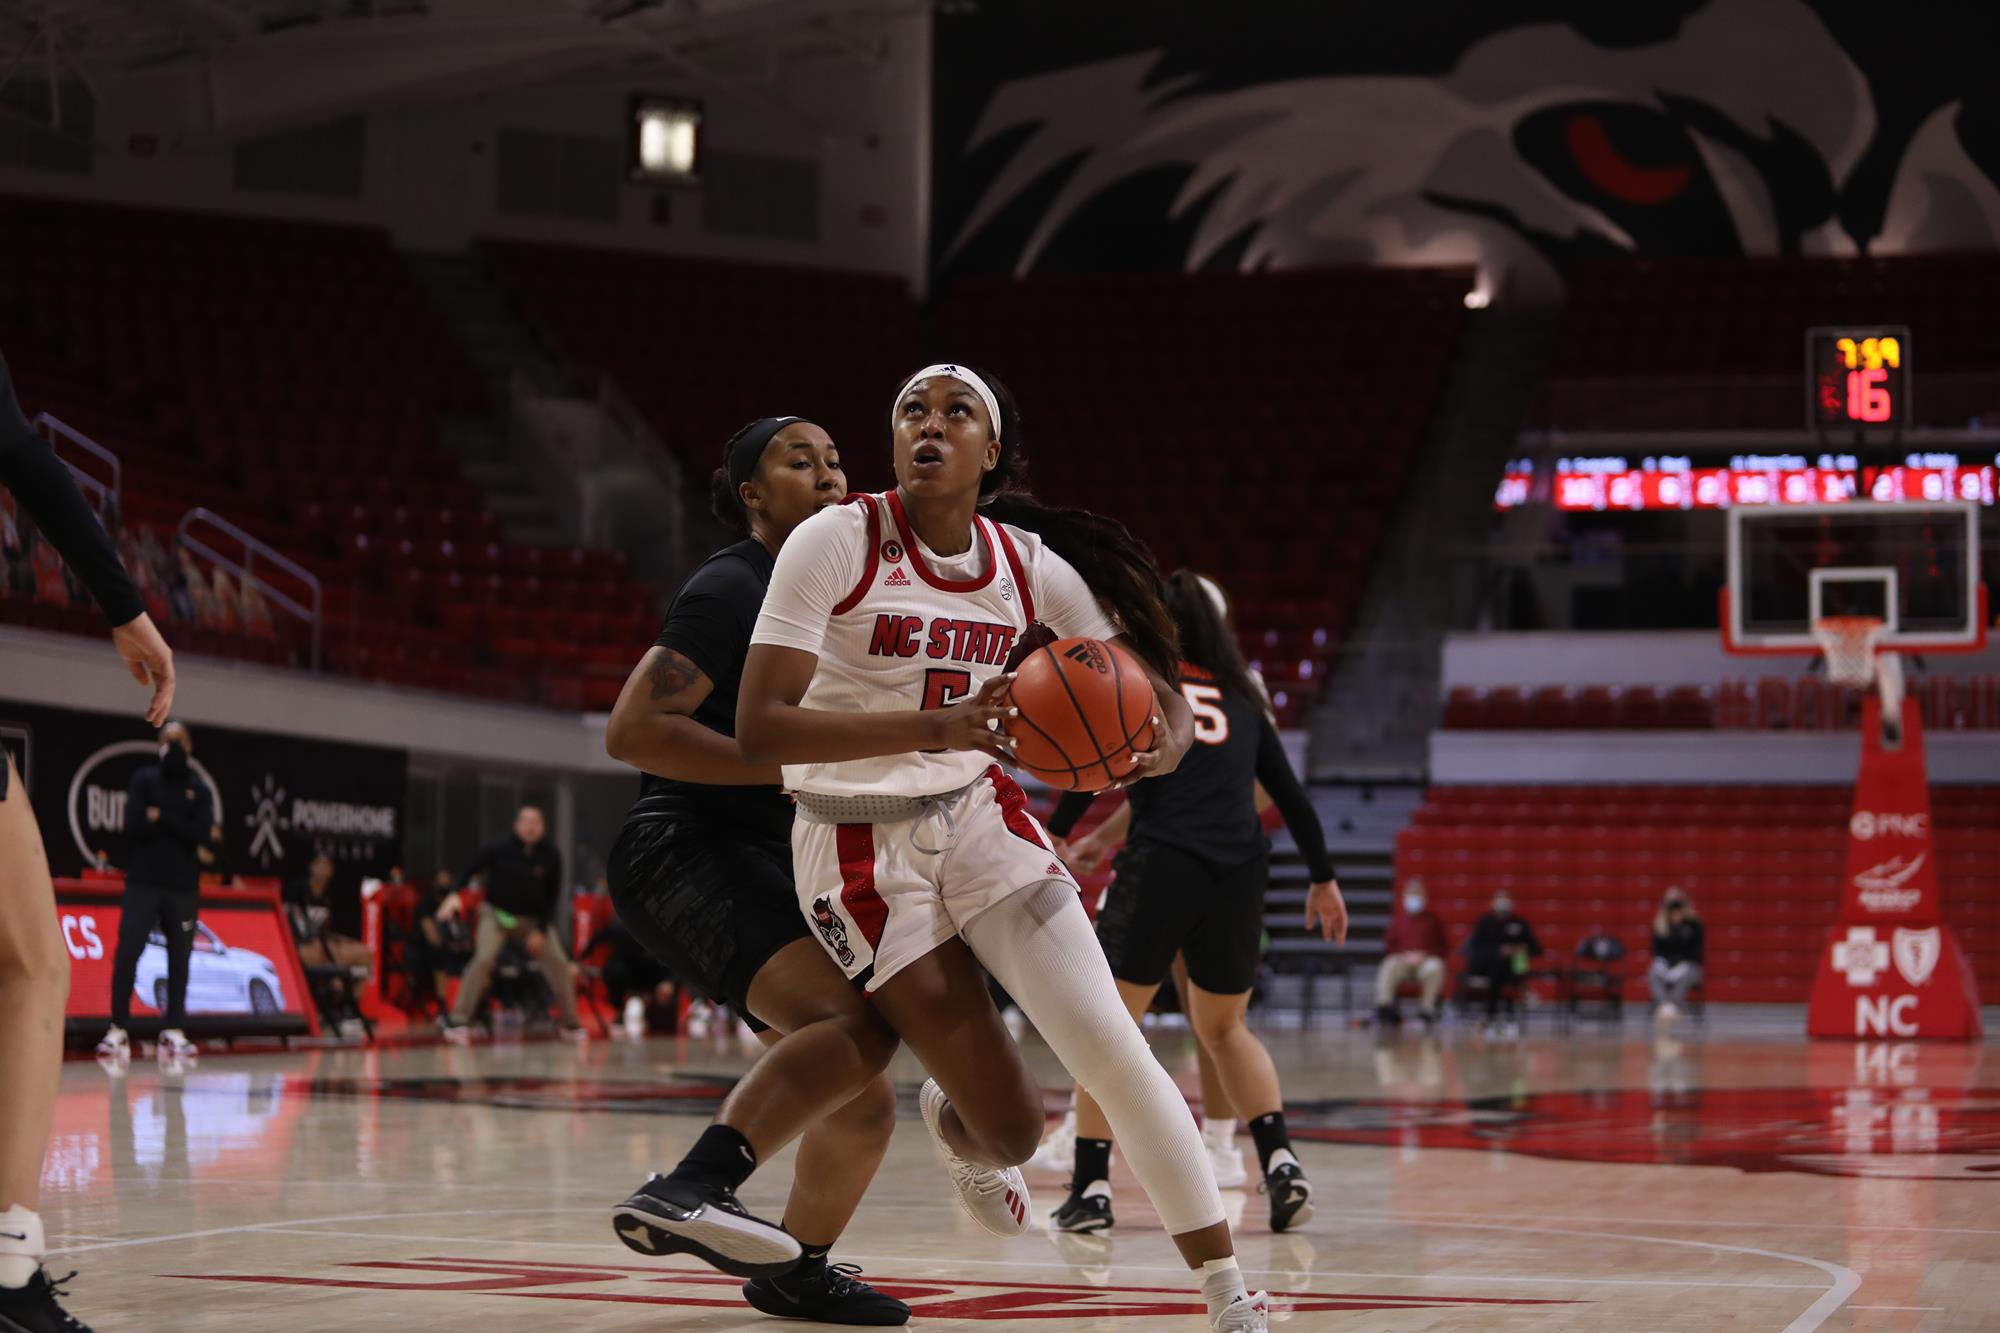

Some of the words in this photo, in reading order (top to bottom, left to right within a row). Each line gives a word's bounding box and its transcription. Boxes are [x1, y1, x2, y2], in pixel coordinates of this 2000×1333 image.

[1847, 369, 1891, 422] 16
[884, 578, 912, 586] adidas
[868, 614, 923, 658] NC
[925, 617, 1017, 666] STATE
[1856, 995, 1920, 1036] NC
